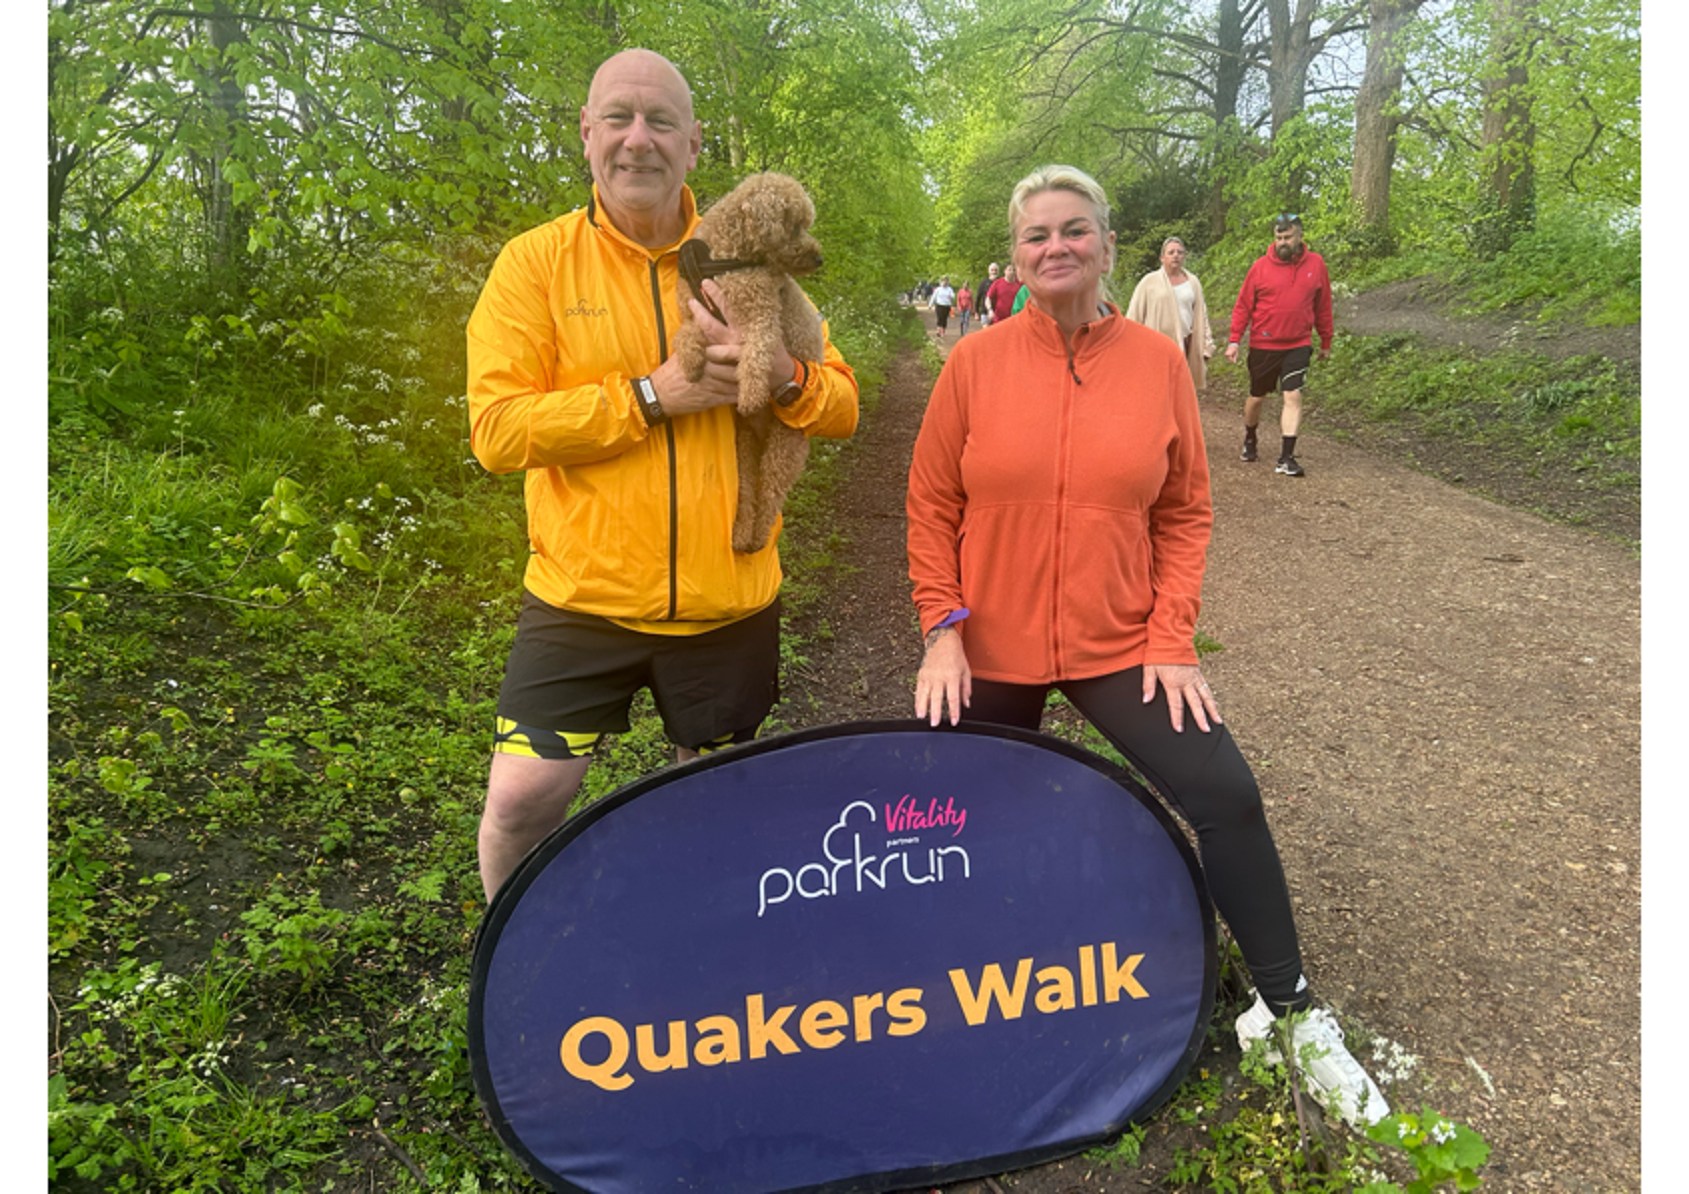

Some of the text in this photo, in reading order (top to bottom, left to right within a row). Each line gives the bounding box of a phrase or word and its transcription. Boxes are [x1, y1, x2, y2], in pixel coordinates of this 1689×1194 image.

[757, 800, 970, 918] parkrun
[884, 794, 967, 837] Vitality
[559, 942, 1150, 1092] Quakers Walk
